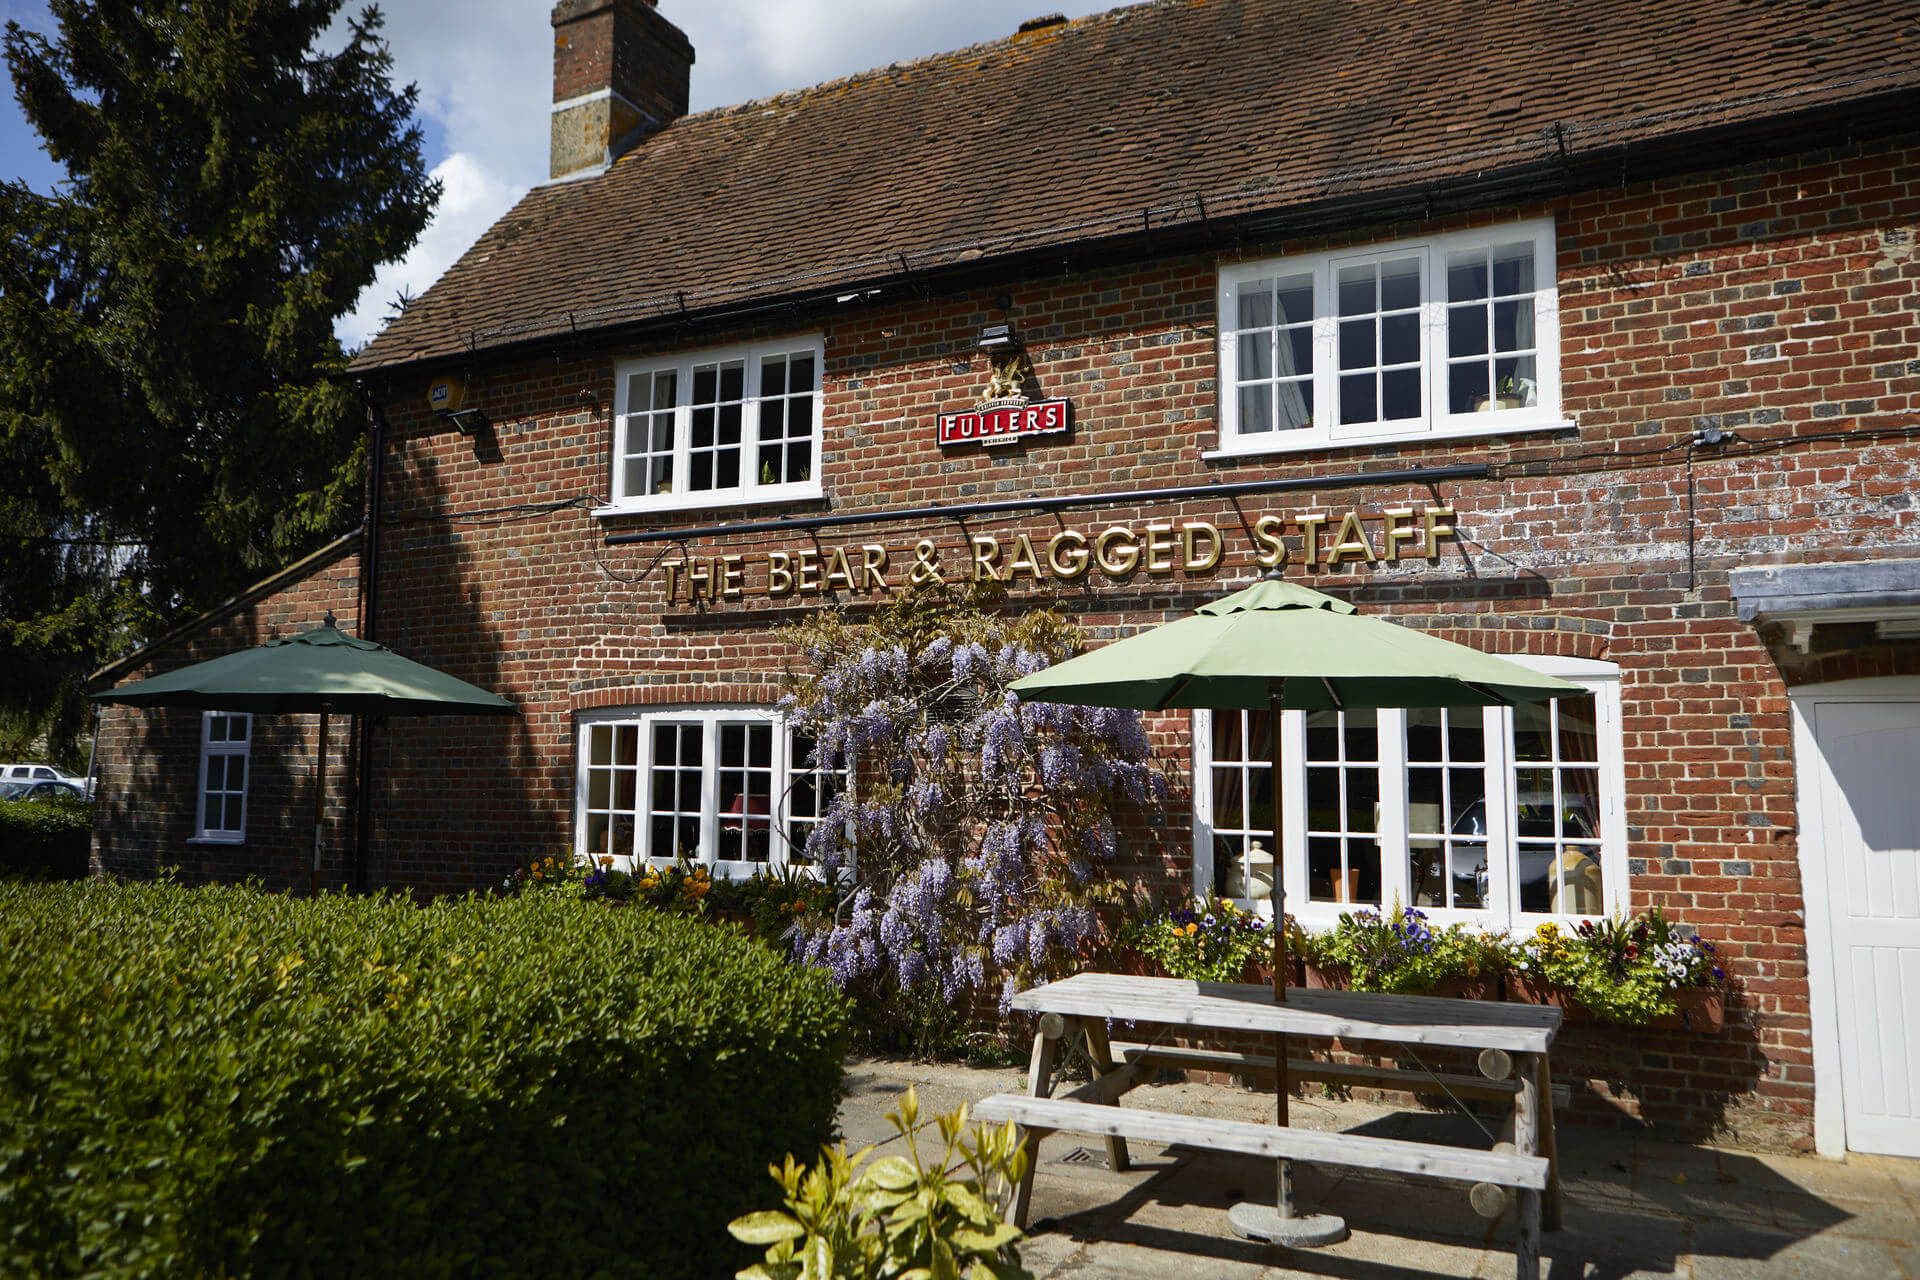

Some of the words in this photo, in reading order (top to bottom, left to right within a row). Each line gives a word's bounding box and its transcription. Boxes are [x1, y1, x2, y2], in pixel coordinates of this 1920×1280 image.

[945, 407, 1057, 438] FULLER'S
[660, 555, 744, 601] THE
[768, 544, 889, 594] BEAR
[909, 539, 945, 586] &
[973, 521, 1221, 582] RAGGED
[1255, 506, 1456, 568] STAFF
